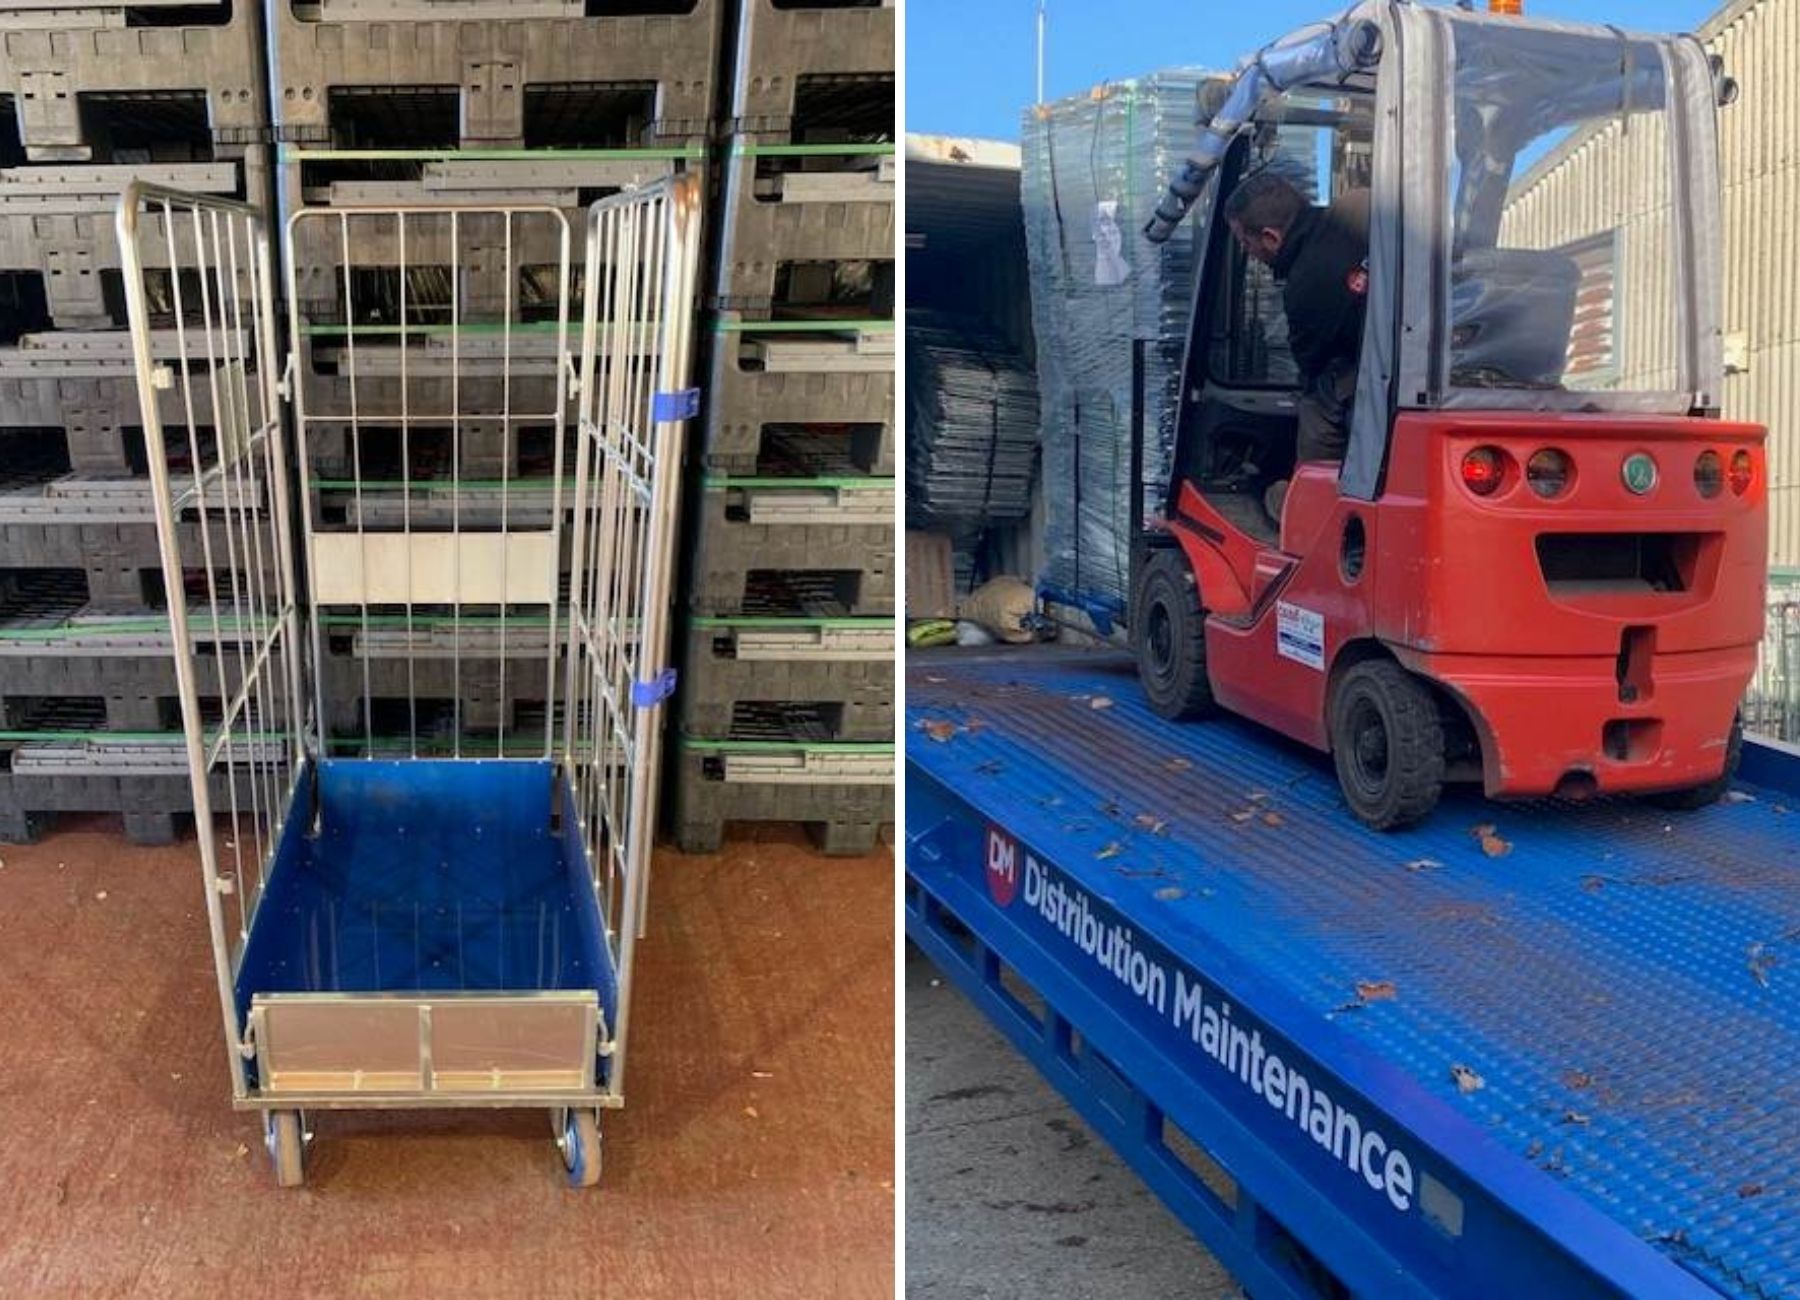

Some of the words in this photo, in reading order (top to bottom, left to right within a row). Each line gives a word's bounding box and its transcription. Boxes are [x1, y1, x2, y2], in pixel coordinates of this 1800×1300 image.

[989, 830, 1014, 884] DM
[1024, 854, 1166, 1014] Distribution
[1173, 970, 1413, 1211] Maintenance
